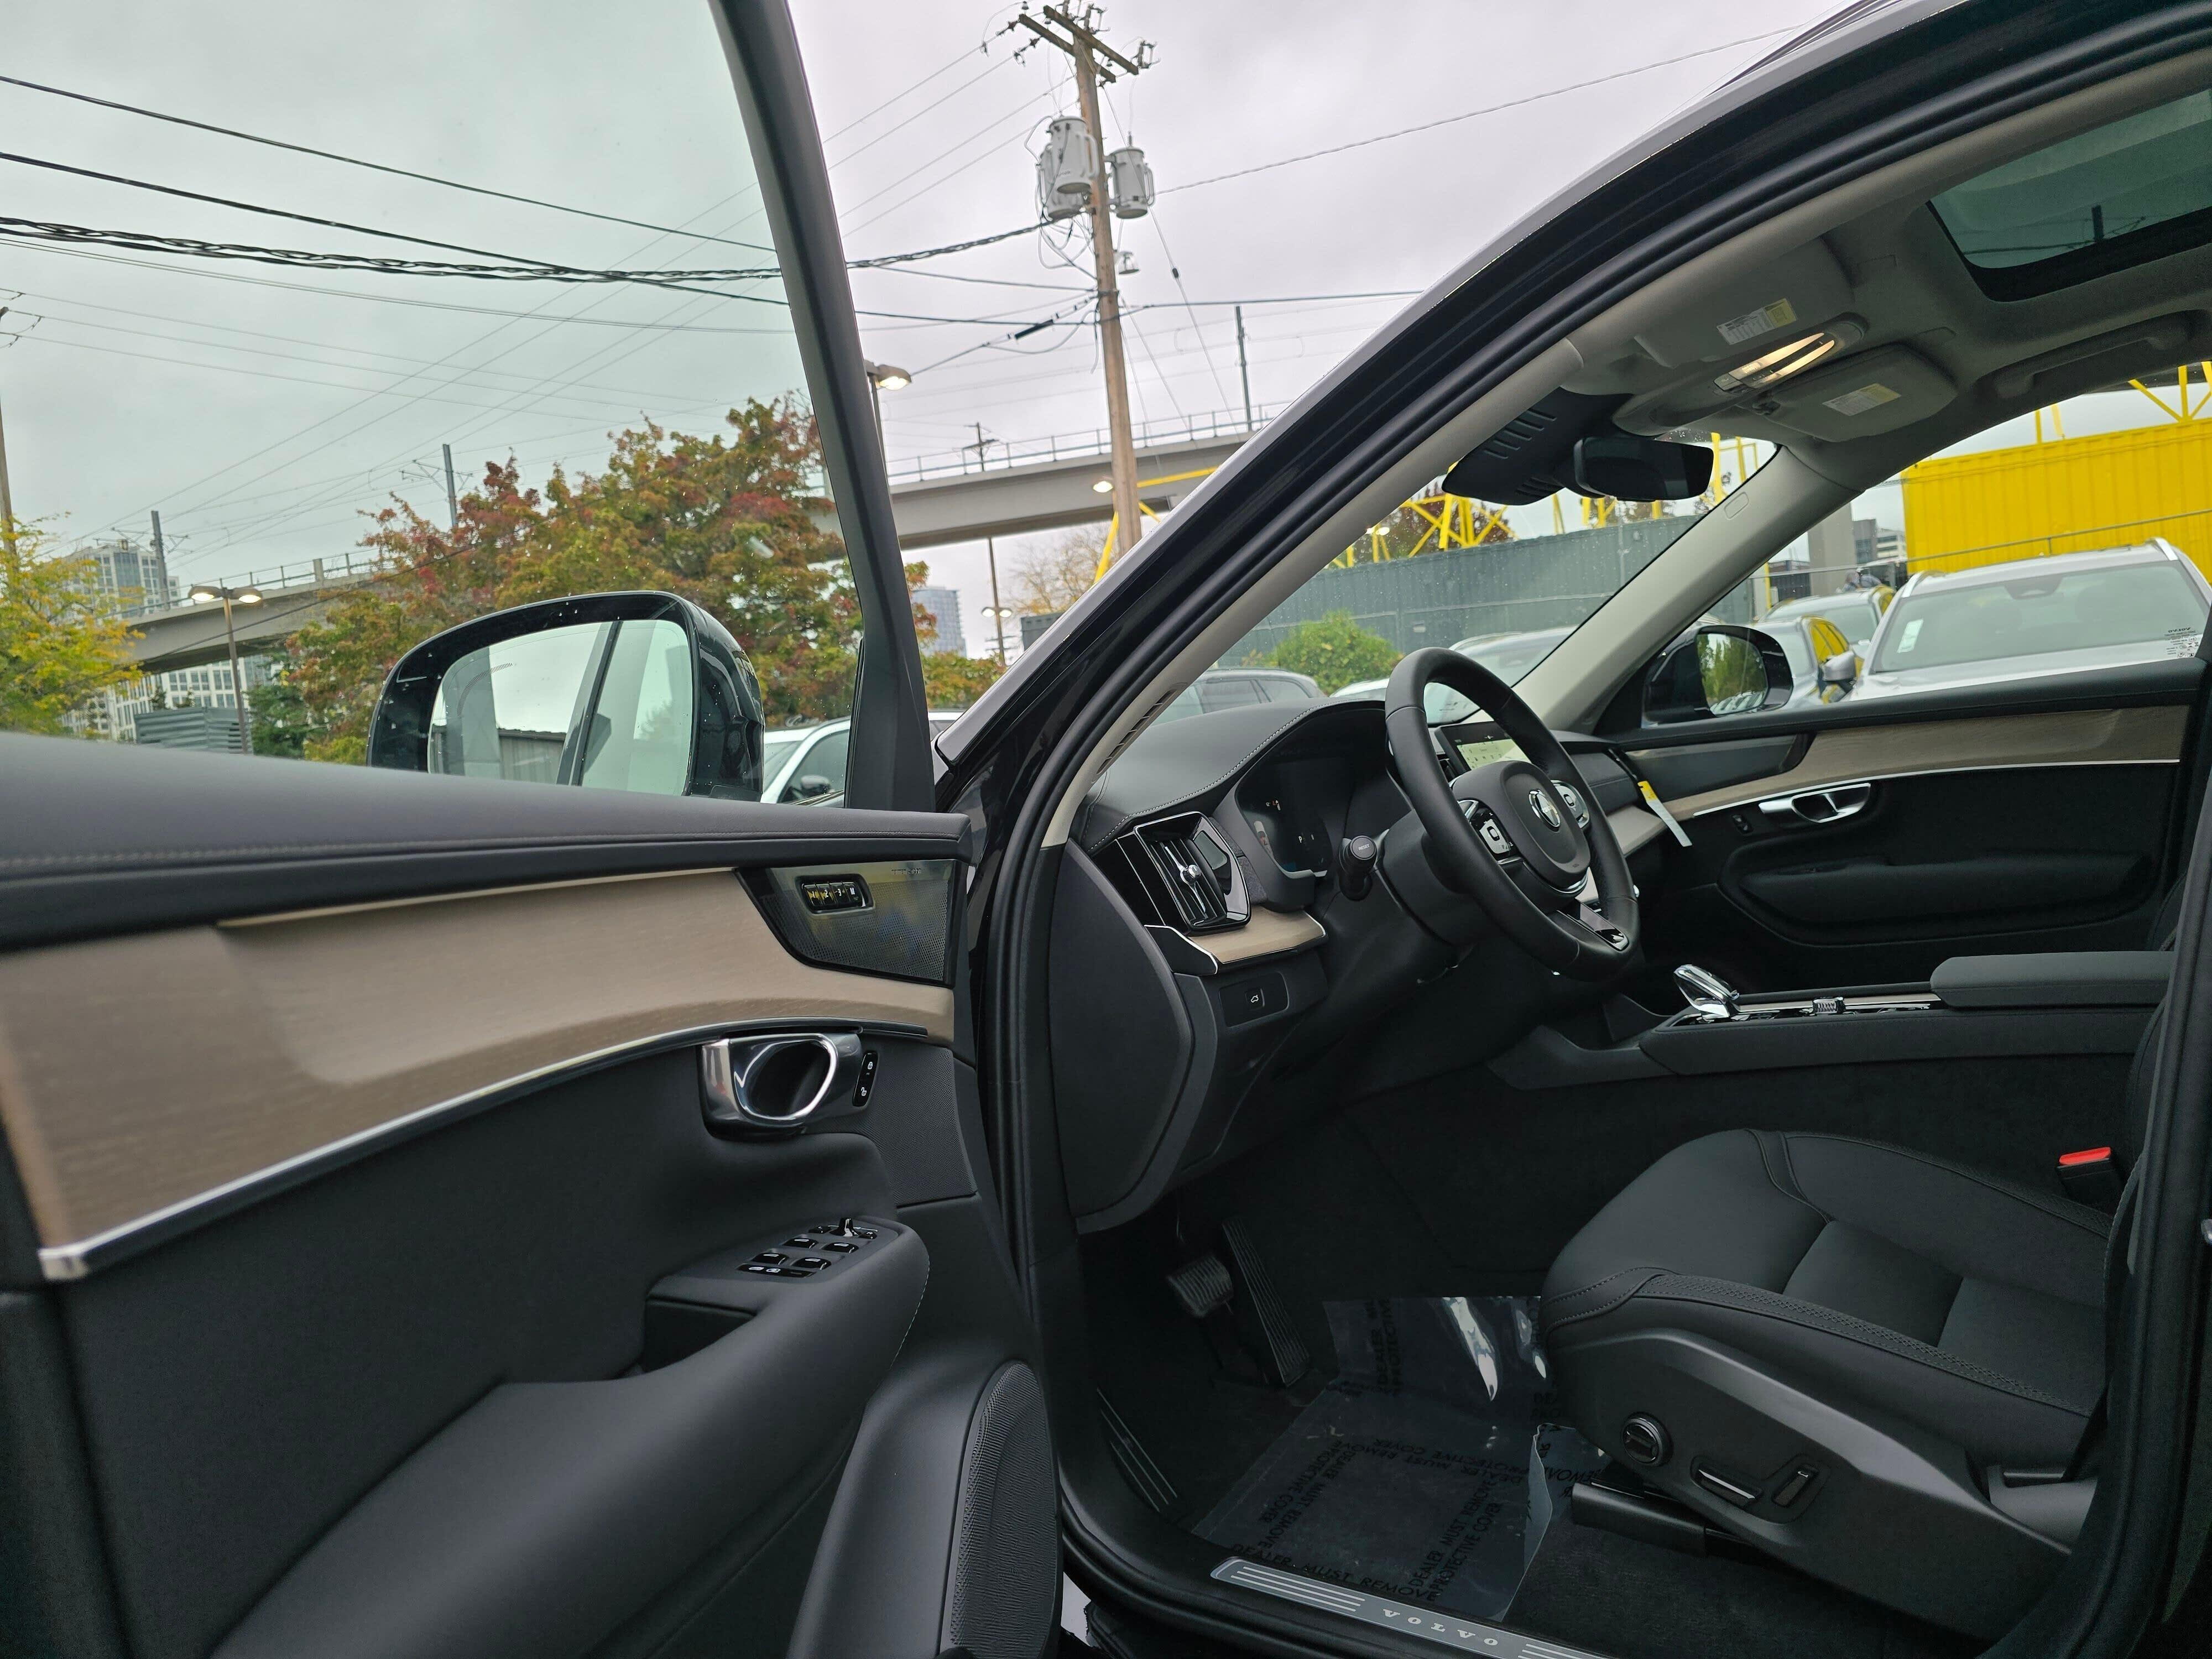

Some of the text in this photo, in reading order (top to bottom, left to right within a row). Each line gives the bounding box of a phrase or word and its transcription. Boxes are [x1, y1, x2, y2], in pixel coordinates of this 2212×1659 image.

[824, 889, 829, 898] 2
[837, 888, 842, 896] 3
[849, 887, 855, 895] M
[1258, 1508, 1302, 1548] REMOVE
[1473, 1502, 1504, 1533] COVER
[1408, 1550, 1444, 1587] DEALER
[1439, 1518, 1467, 1547] MUST
[1301, 1563, 1352, 1582] MUST
[1359, 1576, 1439, 1601] REMOVE
[1383, 1608, 1499, 1646] VOLVO
